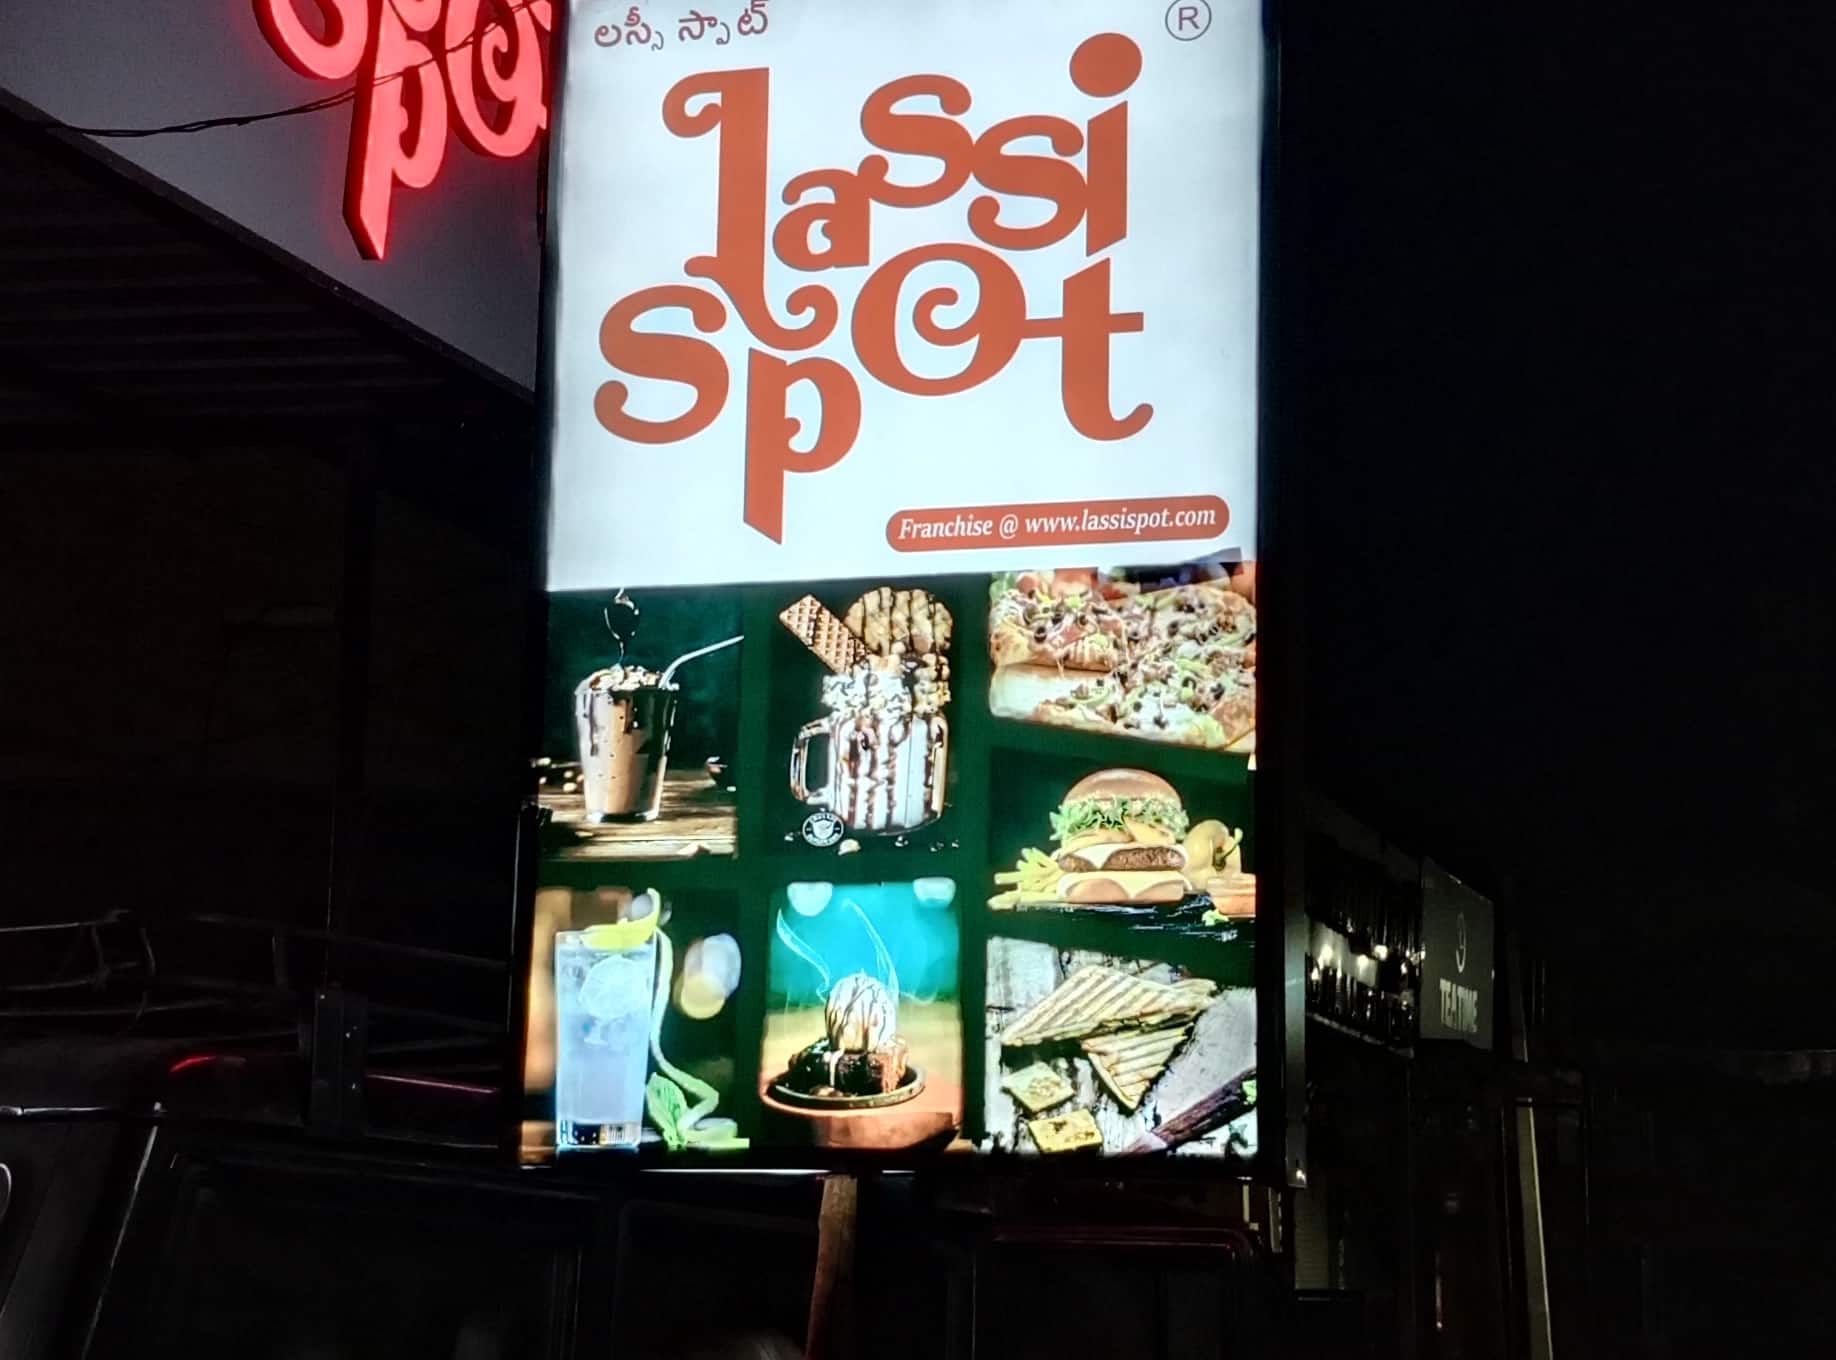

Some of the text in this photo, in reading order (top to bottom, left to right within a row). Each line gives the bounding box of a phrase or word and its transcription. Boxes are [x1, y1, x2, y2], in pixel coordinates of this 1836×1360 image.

[594, 6, 664, 51] లస్సీ
[898, 507, 1216, 540] Franchise @ www.lassispot.com
